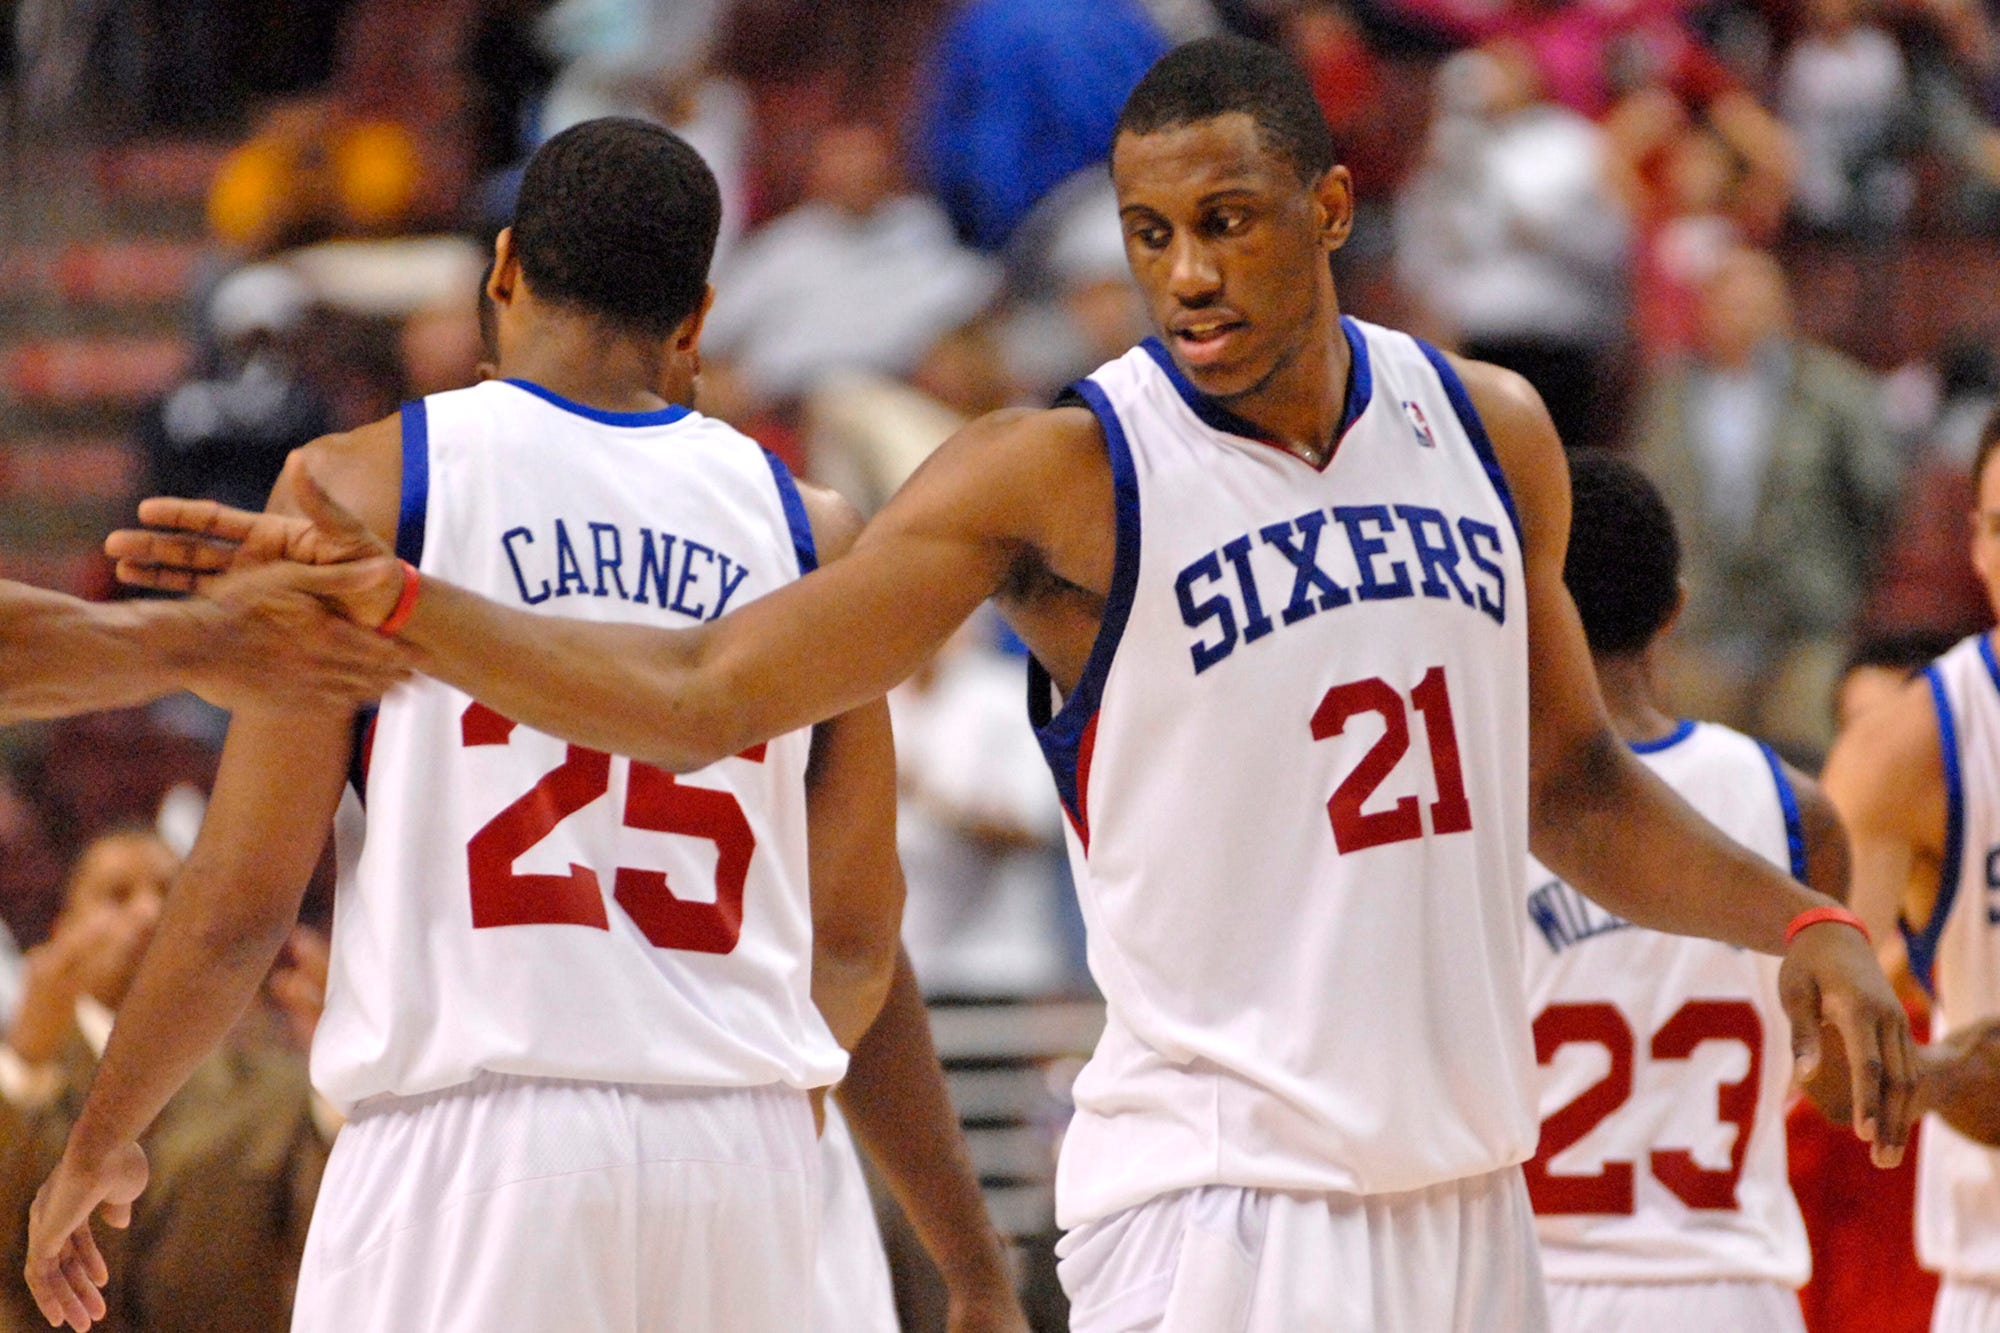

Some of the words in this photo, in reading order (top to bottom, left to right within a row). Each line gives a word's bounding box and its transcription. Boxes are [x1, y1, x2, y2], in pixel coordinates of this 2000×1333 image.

[502, 518, 749, 621] CARNEY
[1174, 504, 1505, 675] SIXERS
[461, 701, 768, 954] 25
[1309, 665, 1472, 855] 21
[1523, 998, 1764, 1215] 23
